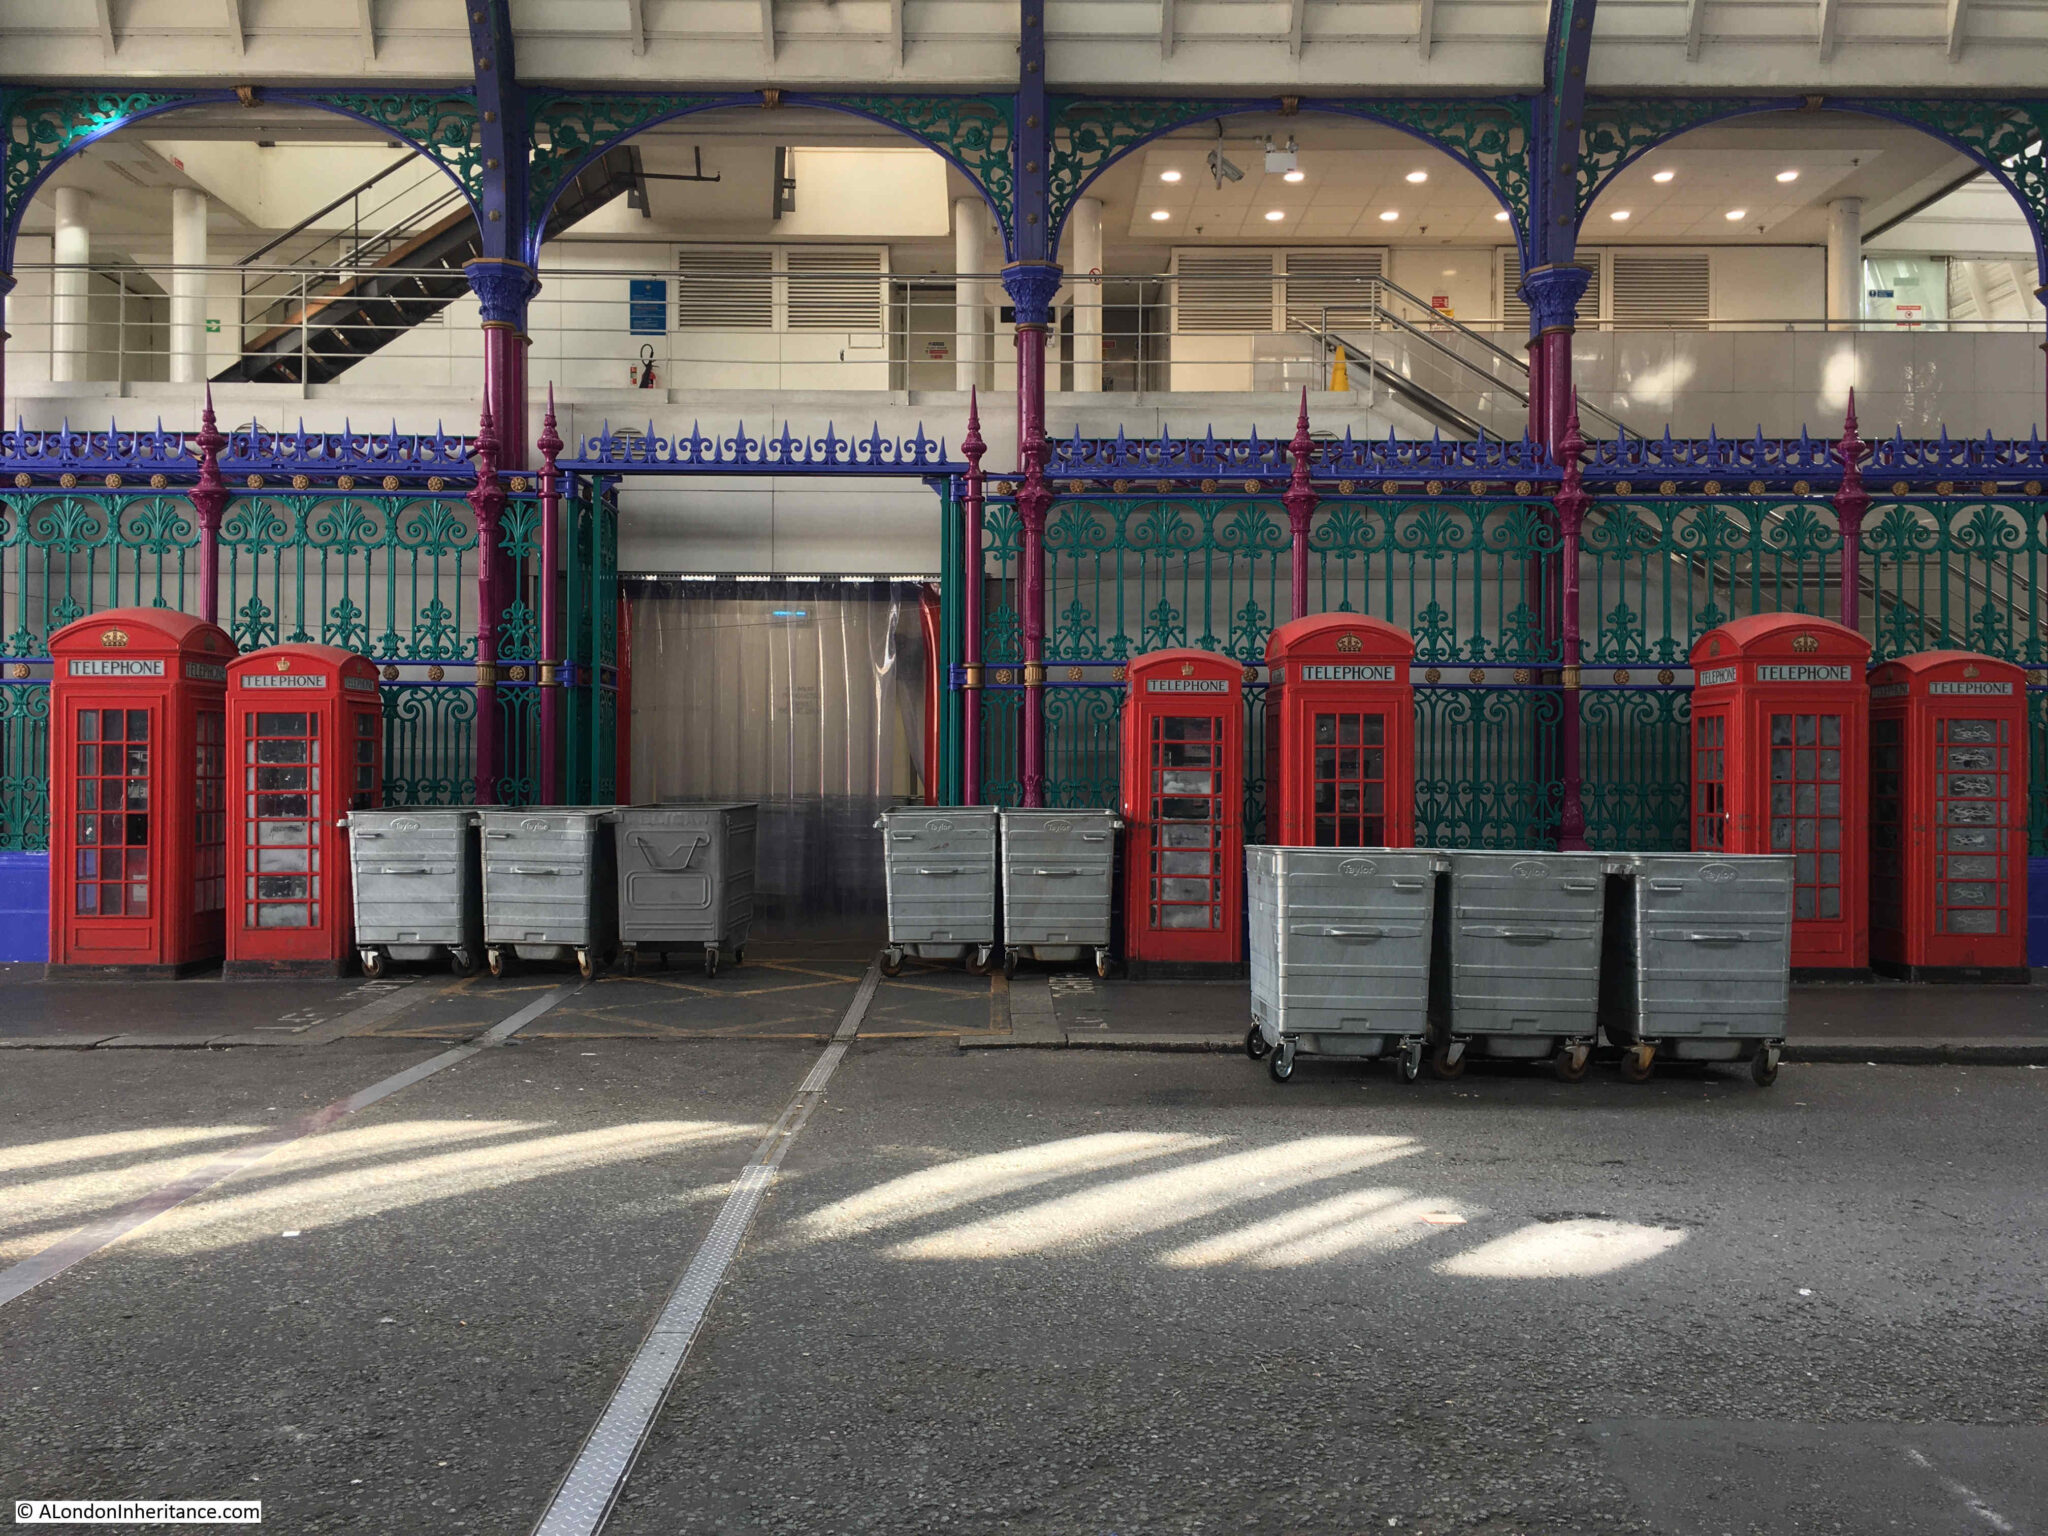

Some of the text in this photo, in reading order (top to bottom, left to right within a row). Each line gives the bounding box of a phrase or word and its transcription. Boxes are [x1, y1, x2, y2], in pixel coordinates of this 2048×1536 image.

[72, 661, 162, 675] TELEPHONE
[1305, 666, 1393, 680] TELEPHONE
[1759, 666, 1849, 680] TELEPHONE
[244, 676, 323, 687] TELEPHONE
[1701, 668, 1736, 684] TELEPHONE
[1150, 680, 1226, 692] TELEPHONE
[1932, 683, 2009, 694] TELEPHONE
[1342, 864, 1375, 877] Taylor
[1702, 869, 1736, 882] Taylor
